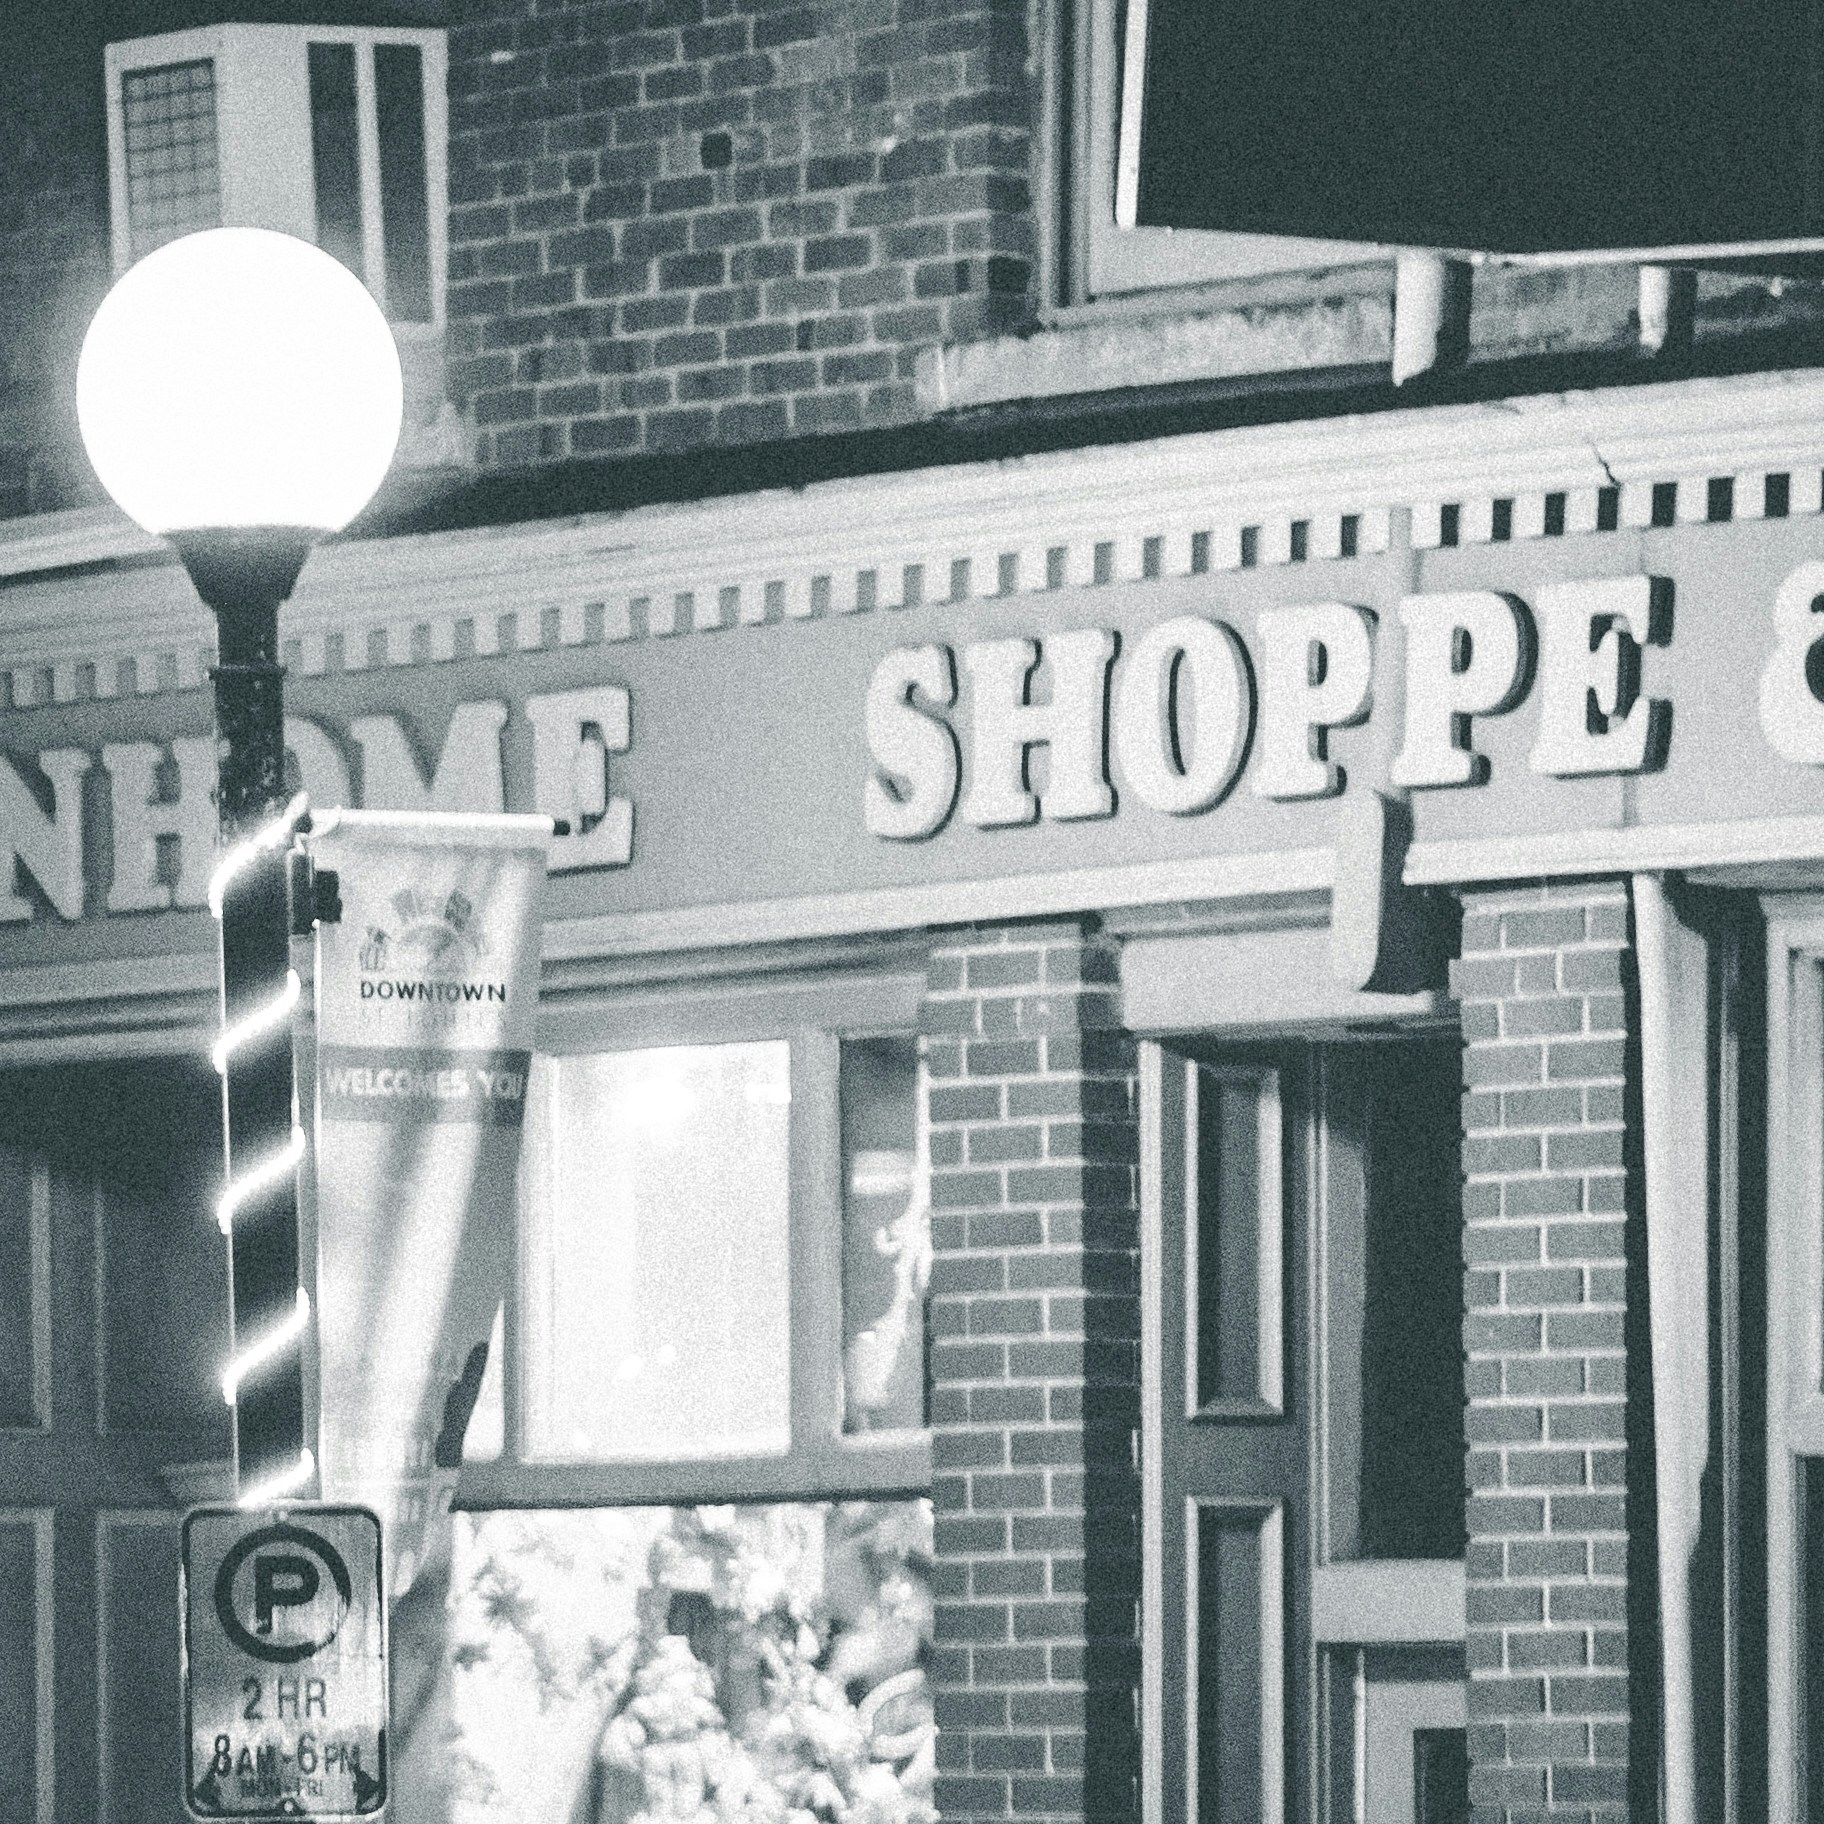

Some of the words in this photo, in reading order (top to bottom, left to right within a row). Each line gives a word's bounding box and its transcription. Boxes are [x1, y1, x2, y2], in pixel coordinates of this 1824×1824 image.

[866, 575, 1671, 842] SHOPPE
[359, 979, 507, 1002] DOWNTOWN
[254, 1555, 321, 1635] P
[242, 1676, 263, 1721] 2
[278, 1677, 326, 1720] HR
